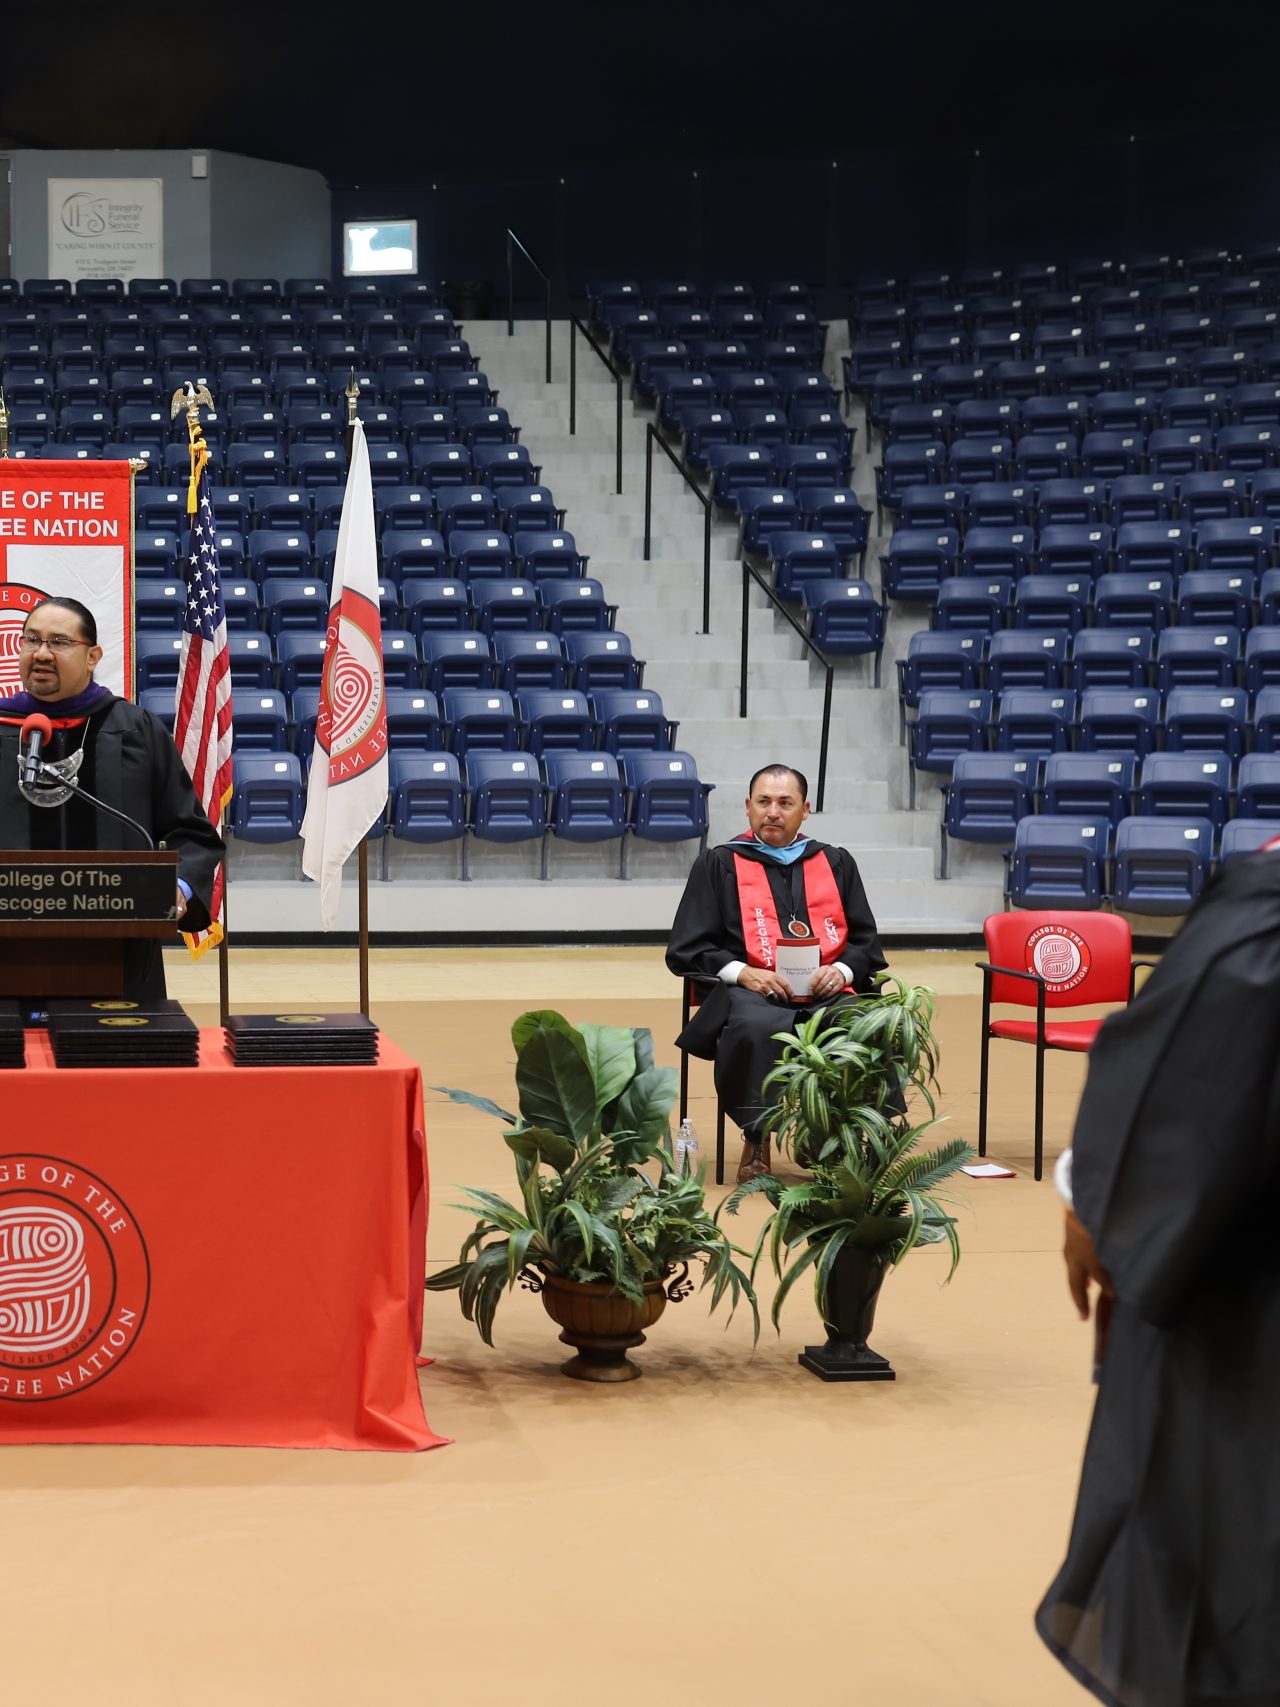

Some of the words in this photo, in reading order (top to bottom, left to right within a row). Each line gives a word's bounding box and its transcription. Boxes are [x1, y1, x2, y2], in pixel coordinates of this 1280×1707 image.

[108, 204, 143, 213] Integrity
[108, 213, 140, 221] Funeral
[108, 222, 140, 230] Service
[22, 491, 53, 509] OF
[59, 491, 105, 509] THE
[33, 519, 118, 537] NATION
[60, 870, 83, 886] Of
[86, 871, 121, 886] The
[73, 894, 134, 910] Nation
[755, 908, 773, 967] REGENT
[824, 917, 840, 944] CMN
[1028, 926, 1054, 946] COLLEGE
[1070, 933, 1083, 946] THE
[1064, 966, 1088, 990] NATION
[41, 1166, 75, 1189] OF
[84, 1185, 127, 1234] THE
[56, 1307, 136, 1390] NATION
